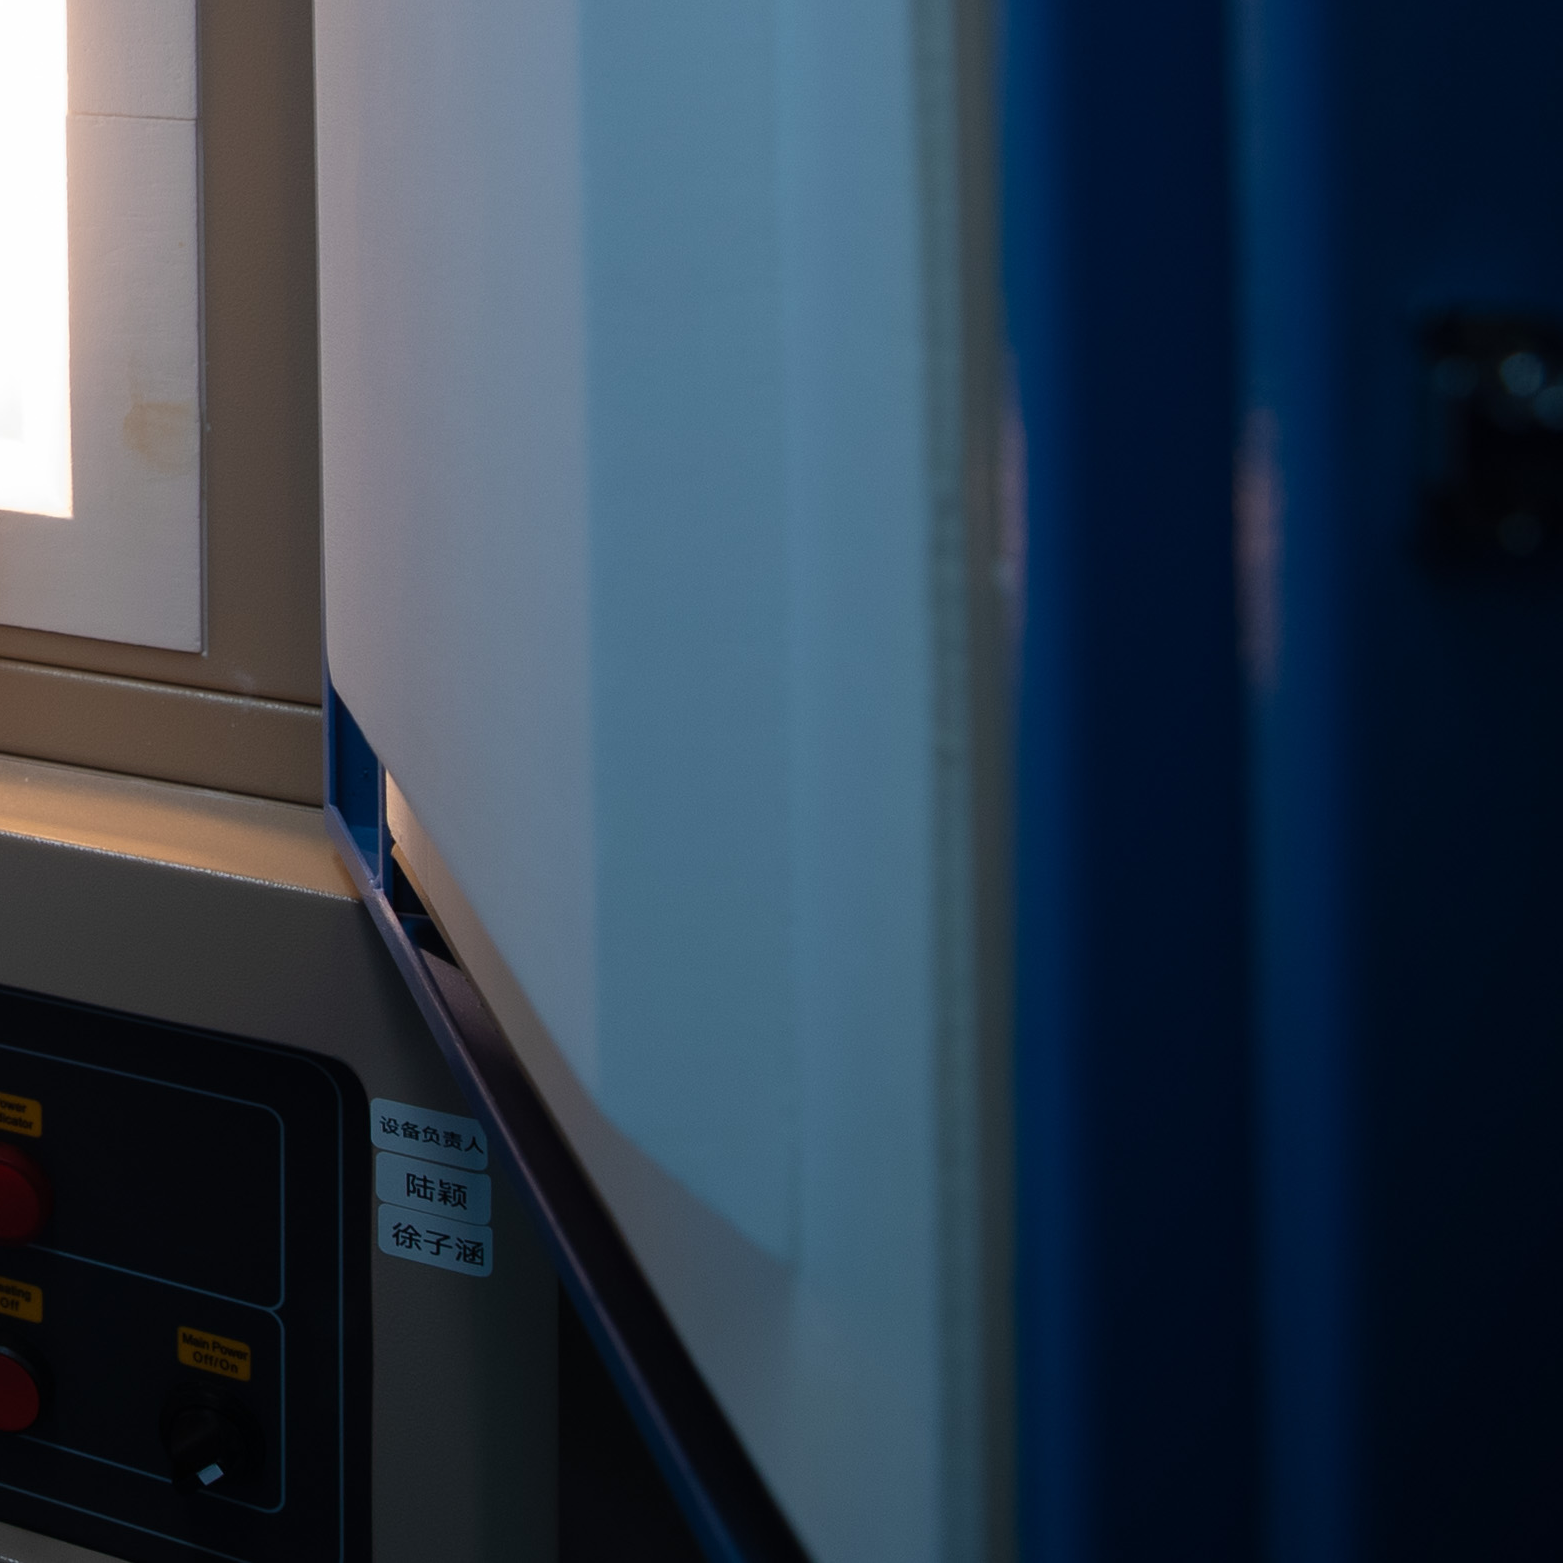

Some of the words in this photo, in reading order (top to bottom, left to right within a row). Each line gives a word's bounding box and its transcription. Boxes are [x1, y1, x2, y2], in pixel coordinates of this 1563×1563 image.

[379, 1115, 485, 1155] 设备负责人
[406, 1172, 468, 1210] 陆颖
[392, 1221, 485, 1267] 徐子涵
[181, 1331, 209, 1352] Main
[211, 1339, 249, 1362] Power
[192, 1349, 239, 1374] Off/On
